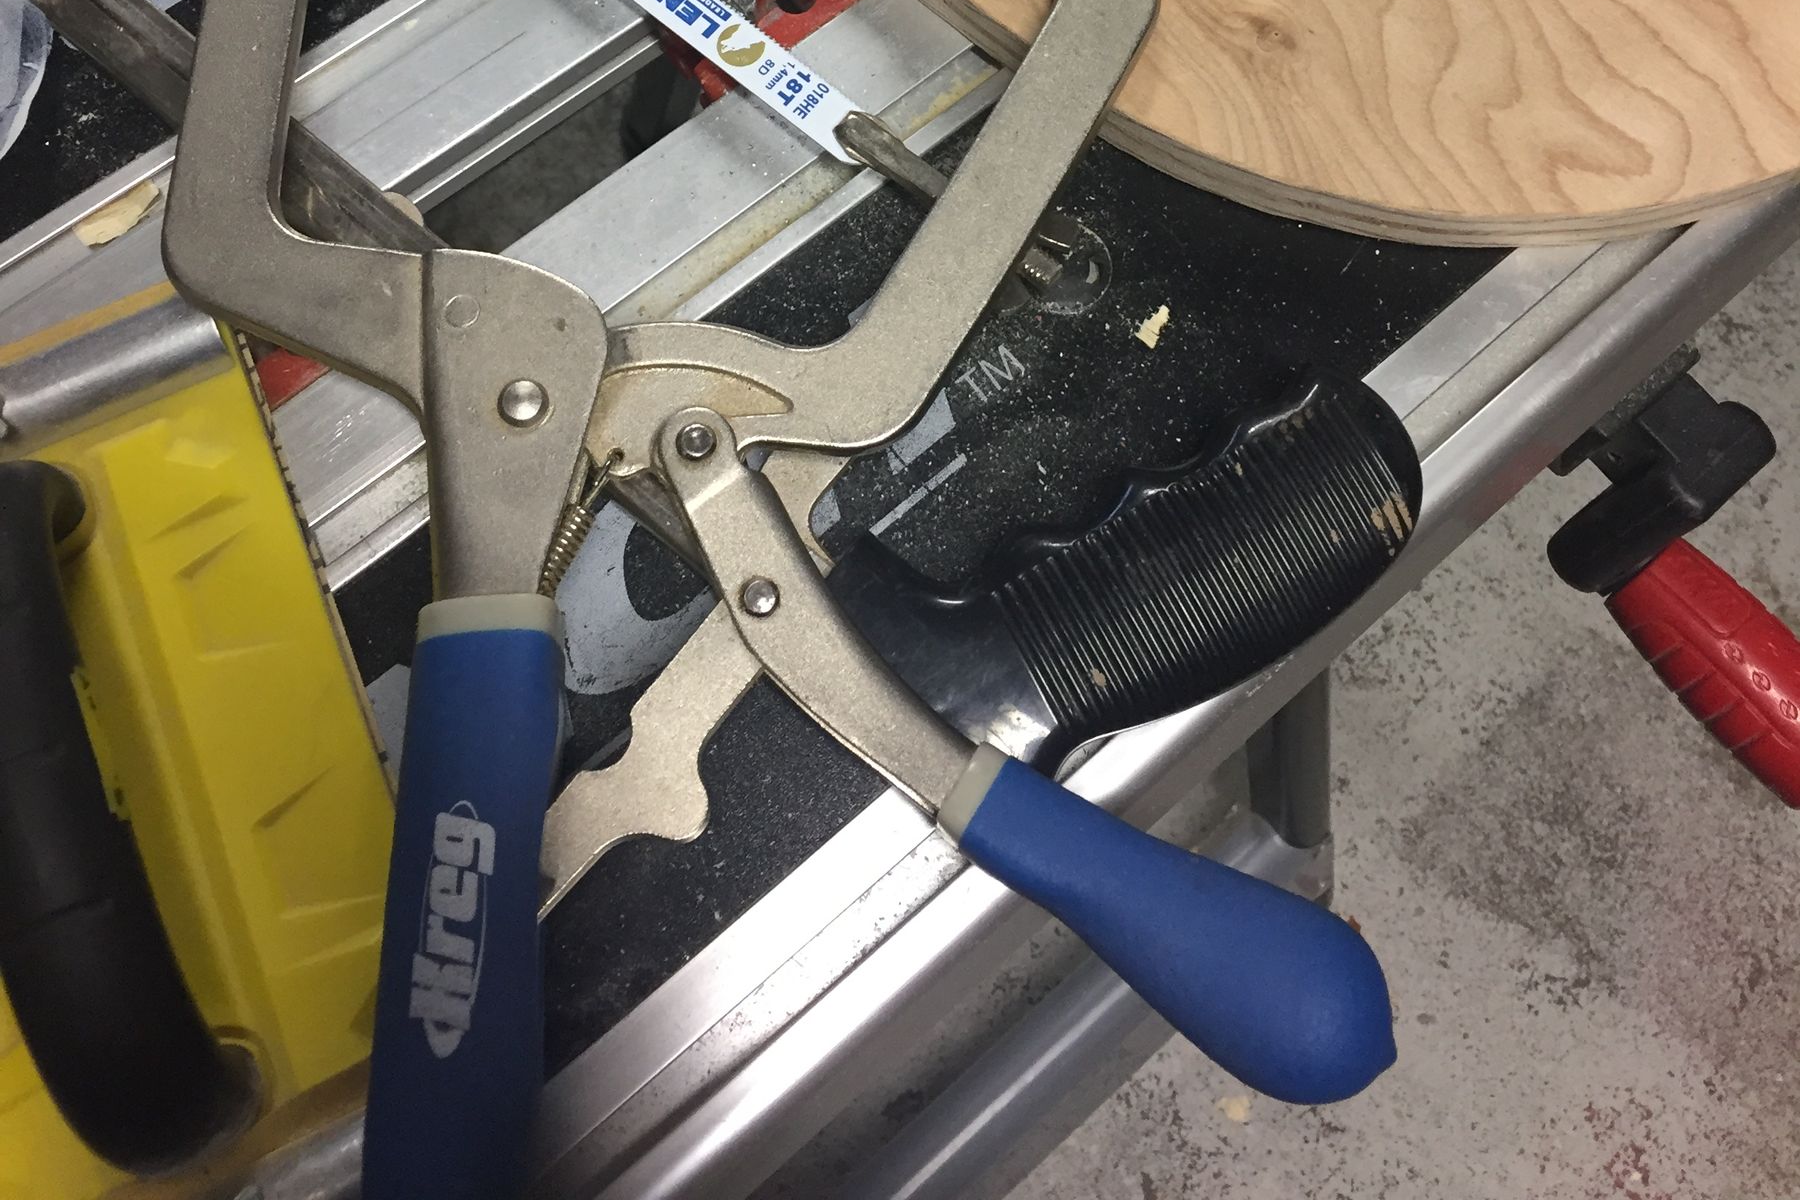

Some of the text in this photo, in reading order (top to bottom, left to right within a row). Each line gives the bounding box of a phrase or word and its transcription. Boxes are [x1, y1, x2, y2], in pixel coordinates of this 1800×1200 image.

[758, 59, 775, 75] 8D
[777, 71, 811, 107] 18T
[792, 83, 830, 120] 018HE
[955, 344, 1026, 402] TM
